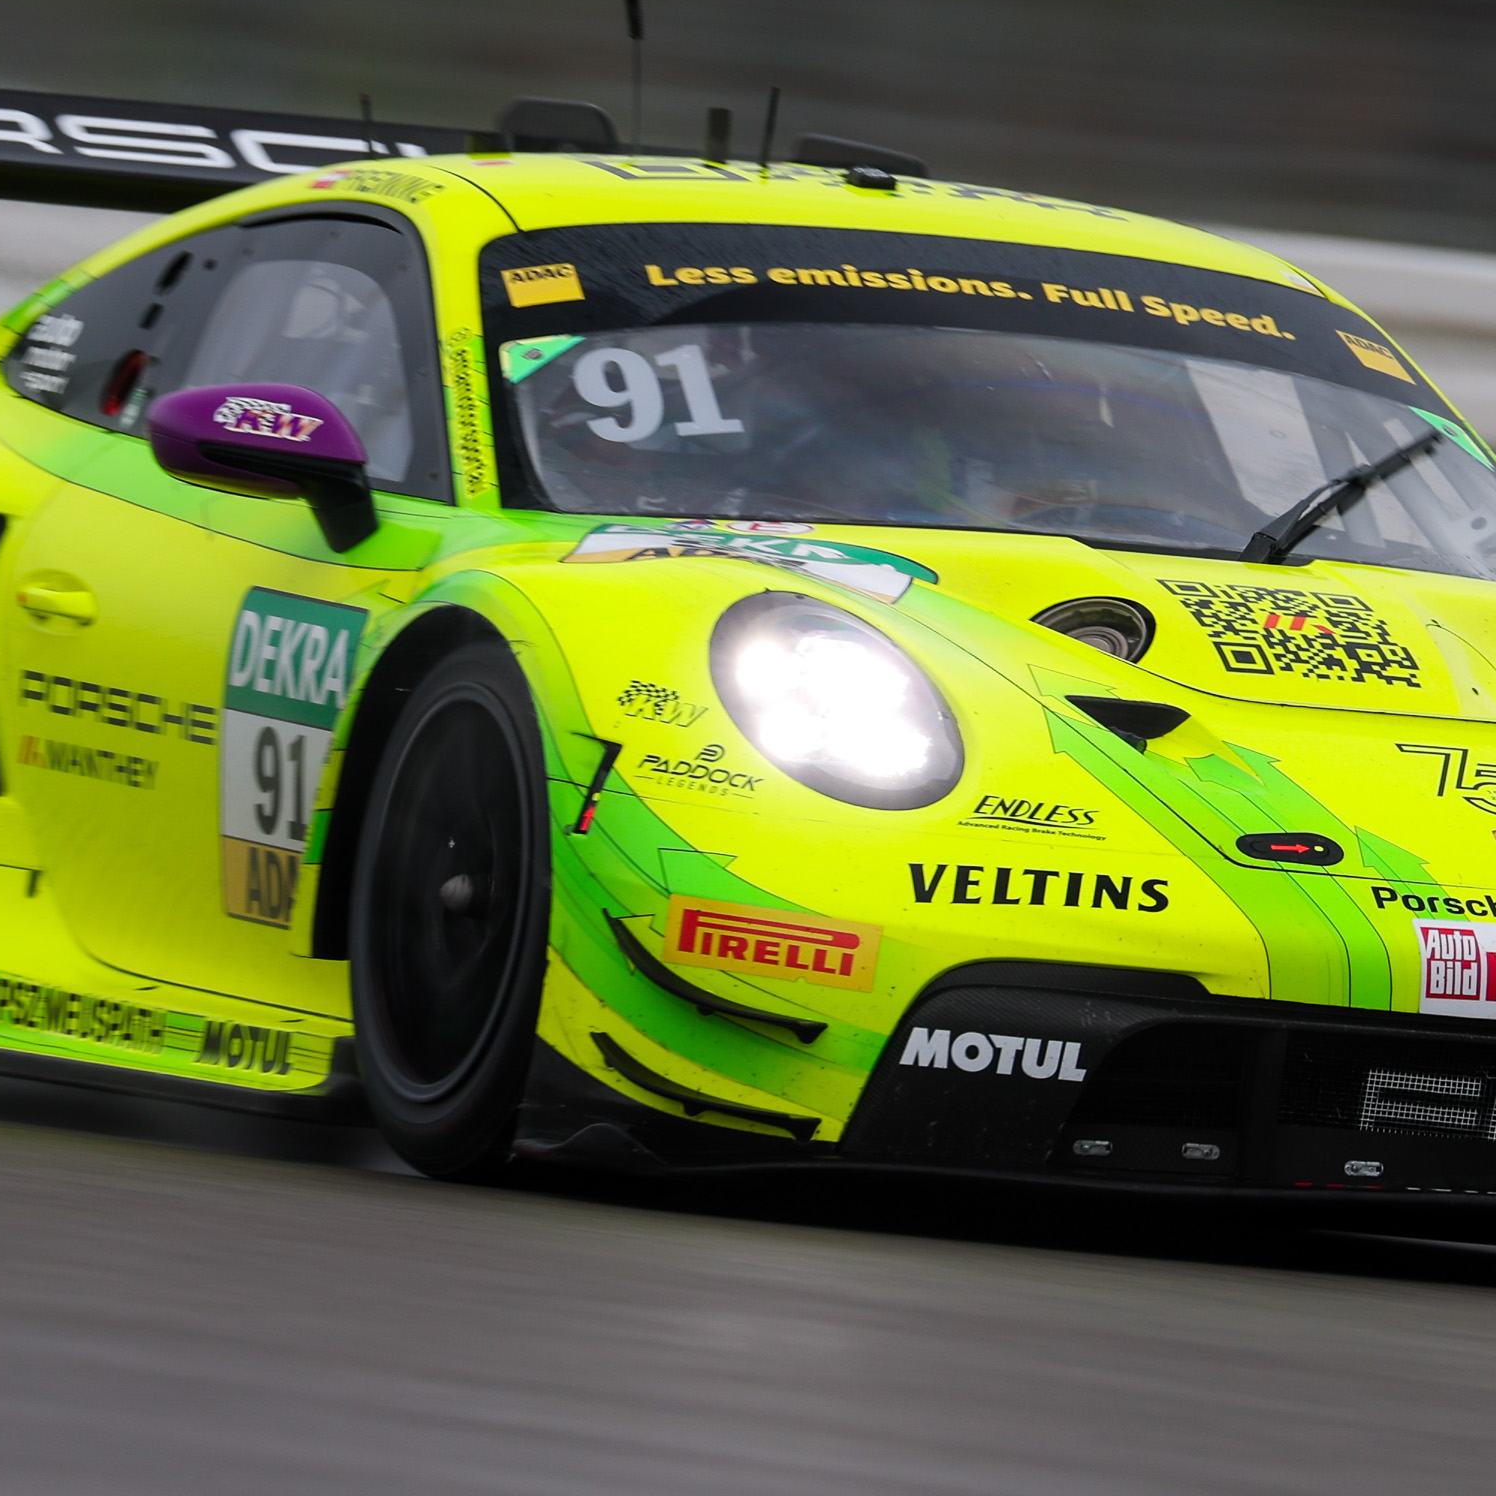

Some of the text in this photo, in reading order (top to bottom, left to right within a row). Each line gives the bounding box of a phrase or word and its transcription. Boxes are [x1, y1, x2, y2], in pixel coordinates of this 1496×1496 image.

[508, 265, 575, 285] ADAC
[645, 264, 1297, 341] Less emissions. Full Speed.
[1342, 331, 1395, 361] ADAC
[572, 344, 746, 443] 91
[228, 609, 351, 710] DEKRA
[17, 668, 218, 746] PORSCHE
[255, 726, 308, 842] 91
[637, 754, 765, 792] PADDOCK
[656, 775, 731, 797] LEGENDS
[957, 820, 1107, 842] Advanced Racing Brake Technology
[973, 794, 1100, 826] ENDLESS
[908, 862, 1170, 913] VELTINS
[677, 908, 861, 977] PIRELLI
[1425, 928, 1478, 962] Auto
[1429, 960, 1480, 996] Bild
[193, 1016, 294, 1076] MOTUL
[898, 1026, 1088, 1083] MOTUL
